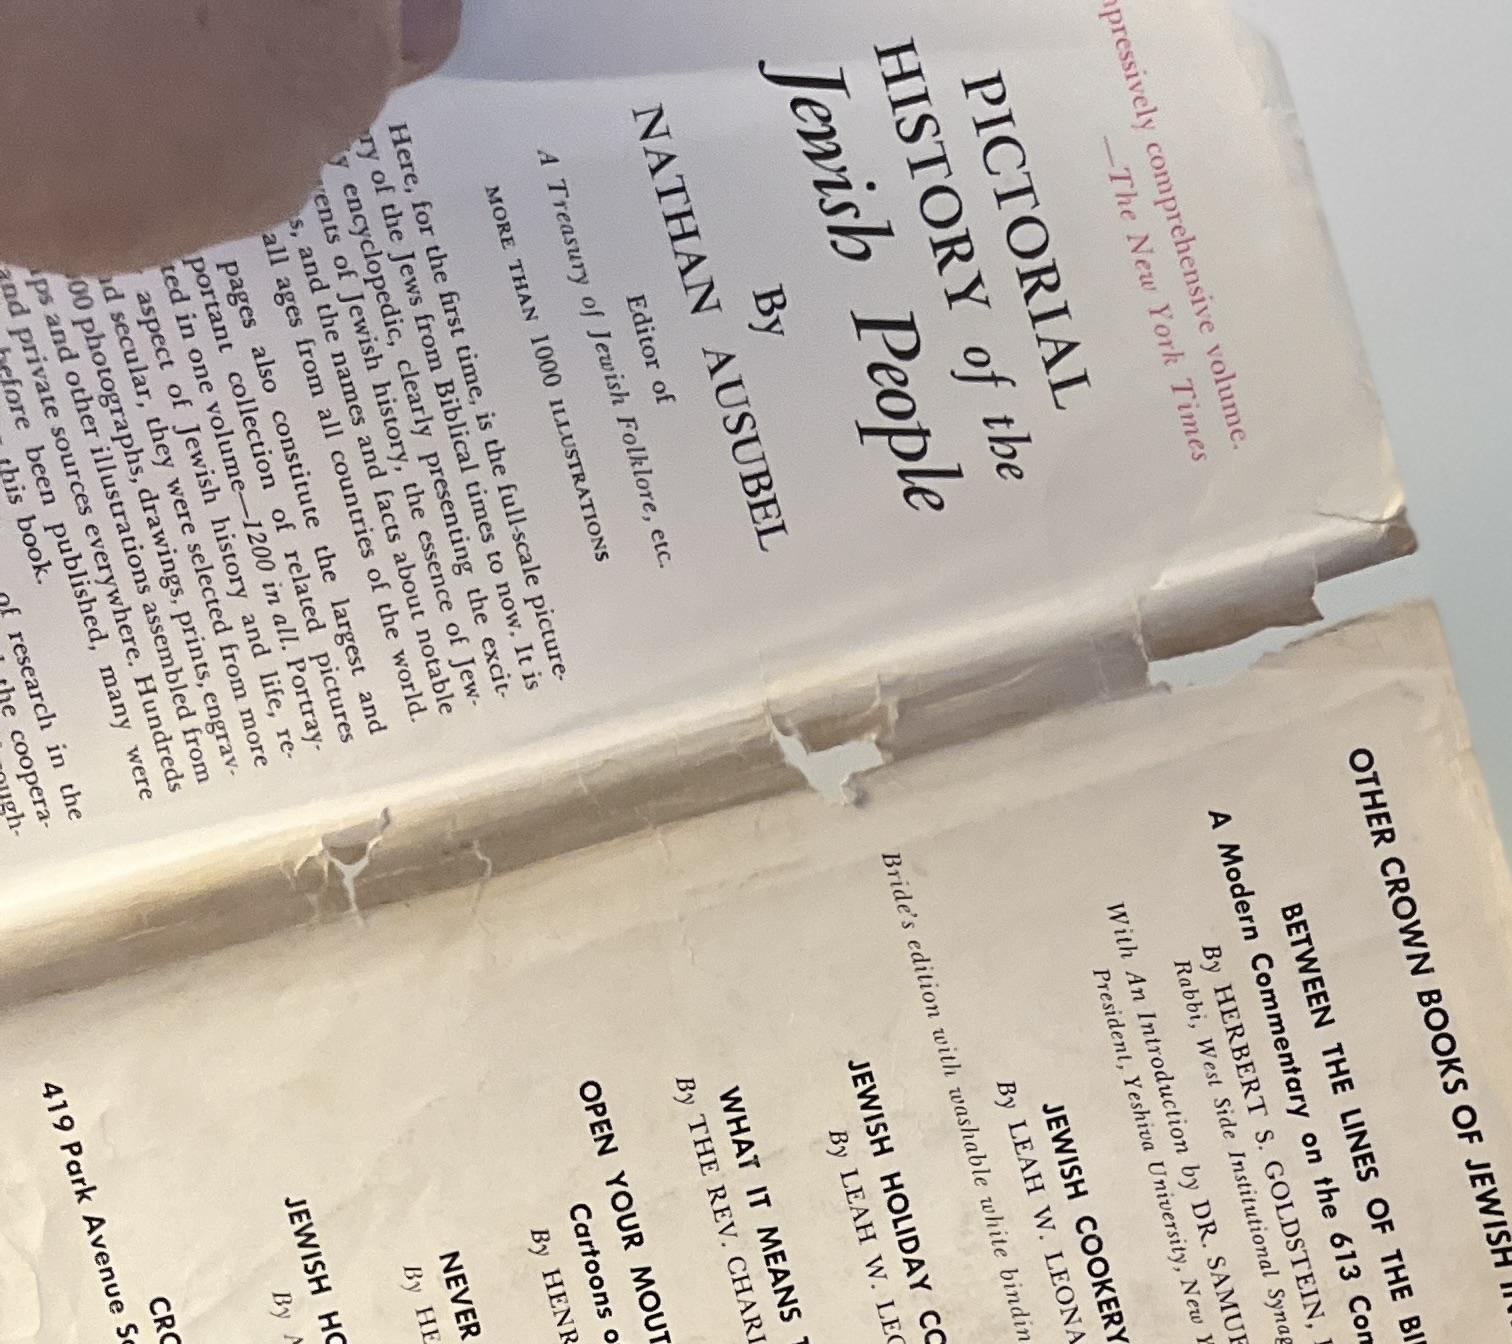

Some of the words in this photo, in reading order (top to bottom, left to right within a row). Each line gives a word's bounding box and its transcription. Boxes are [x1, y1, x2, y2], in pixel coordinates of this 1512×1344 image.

[387, 123, 418, 193] Here,
[536, 149, 560, 166] A
[872, 36, 991, 310] HISTORY
[411, 200, 434, 236] for
[425, 244, 448, 283] the
[546, 177, 589, 284] Treasury
[960, 69, 1091, 410] PICTORIAL
[1145, 141, 1214, 333] comprehensive
[438, 290, 465, 338] first
[579, 295, 605, 316] of
[631, 102, 722, 314] NATHAN
[701, 347, 788, 552] AUSUBEL
[747, 282, 787, 336] By
[757, 58, 895, 261] Jewish
[849, 309, 964, 511] People
[455, 344, 482, 405] time,
[484, 185, 515, 250] MORE
[508, 258, 539, 321] THAN
[529, 333, 562, 387] 1000
[548, 398, 609, 562] ILLUSTRATIONS
[585, 329, 630, 405] Jewish
[625, 293, 660, 369] Editor
[651, 379, 676, 404] of
[954, 346, 1016, 387] of
[1125, 233, 1156, 291] New
[1148, 302, 1185, 365] York
[1170, 377, 1206, 461] Times
[474, 411, 496, 431] is
[483, 438, 506, 477] the
[615, 416, 657, 521] Folklore,
[981, 414, 1032, 480] the
[215, 260, 256, 328] pages
[250, 346, 276, 393] also
[271, 409, 319, 529] constitute
[313, 544, 336, 583] the
[329, 597, 365, 676] largest
[358, 690, 388, 735] and
[496, 483, 541, 587] full-scale
[650, 528, 671, 568] etc.
[523, 593, 566, 681] picture-
[1207, 810, 1232, 830] A
[1216, 843, 1258, 941] Modern
[1348, 747, 1396, 848] OTHER
[1379, 856, 1435, 976] CROWN
[1415, 988, 1468, 1094] BOOKS
[1451, 1103, 1484, 1144] OF
[1250, 952, 1310, 1118] Commentary
[718, 1084, 761, 1168] WHAT
[1091, 968, 1132, 1069] President,
[1122, 1074, 1154, 1151] Yeshiva
[1147, 1160, 1187, 1272] University,
[1179, 1278, 1203, 1324] New
[1199, 944, 1222, 972] By
[1213, 983, 1268, 1116] HERBERT
[1254, 1129, 1274, 1150] S.
[1264, 1160, 1325, 1328] GOLDSTEIN,
[1280, 901, 1336, 1029] BETWEEN
[1321, 1041, 1354, 1095] THE
[1339, 1107, 1379, 1182] LINES
[1365, 1197, 1395, 1234] OF
[1380, 1247, 1413, 1302] THE
[1300, 1131, 1322, 1164] on
[41, 1081, 75, 1131] 419
[59, 1140, 97, 1204] Park
[81, 1214, 124, 1314] Avenue
[578, 1079, 619, 1156] OPEN
[604, 1169, 644, 1251] YOUR
[745, 1185, 772, 1208] IT
[847, 1059, 894, 1157] JEWISH
[879, 1170, 932, 1290] HOLIDAY
[1313, 1176, 1340, 1219] the
[1041, 1102, 1089, 1200] JEWISH
[1074, 1215, 1130, 1343] COOKERY
[1329, 1231, 1361, 1281] 613
[755, 1225, 802, 1322] MEANS
